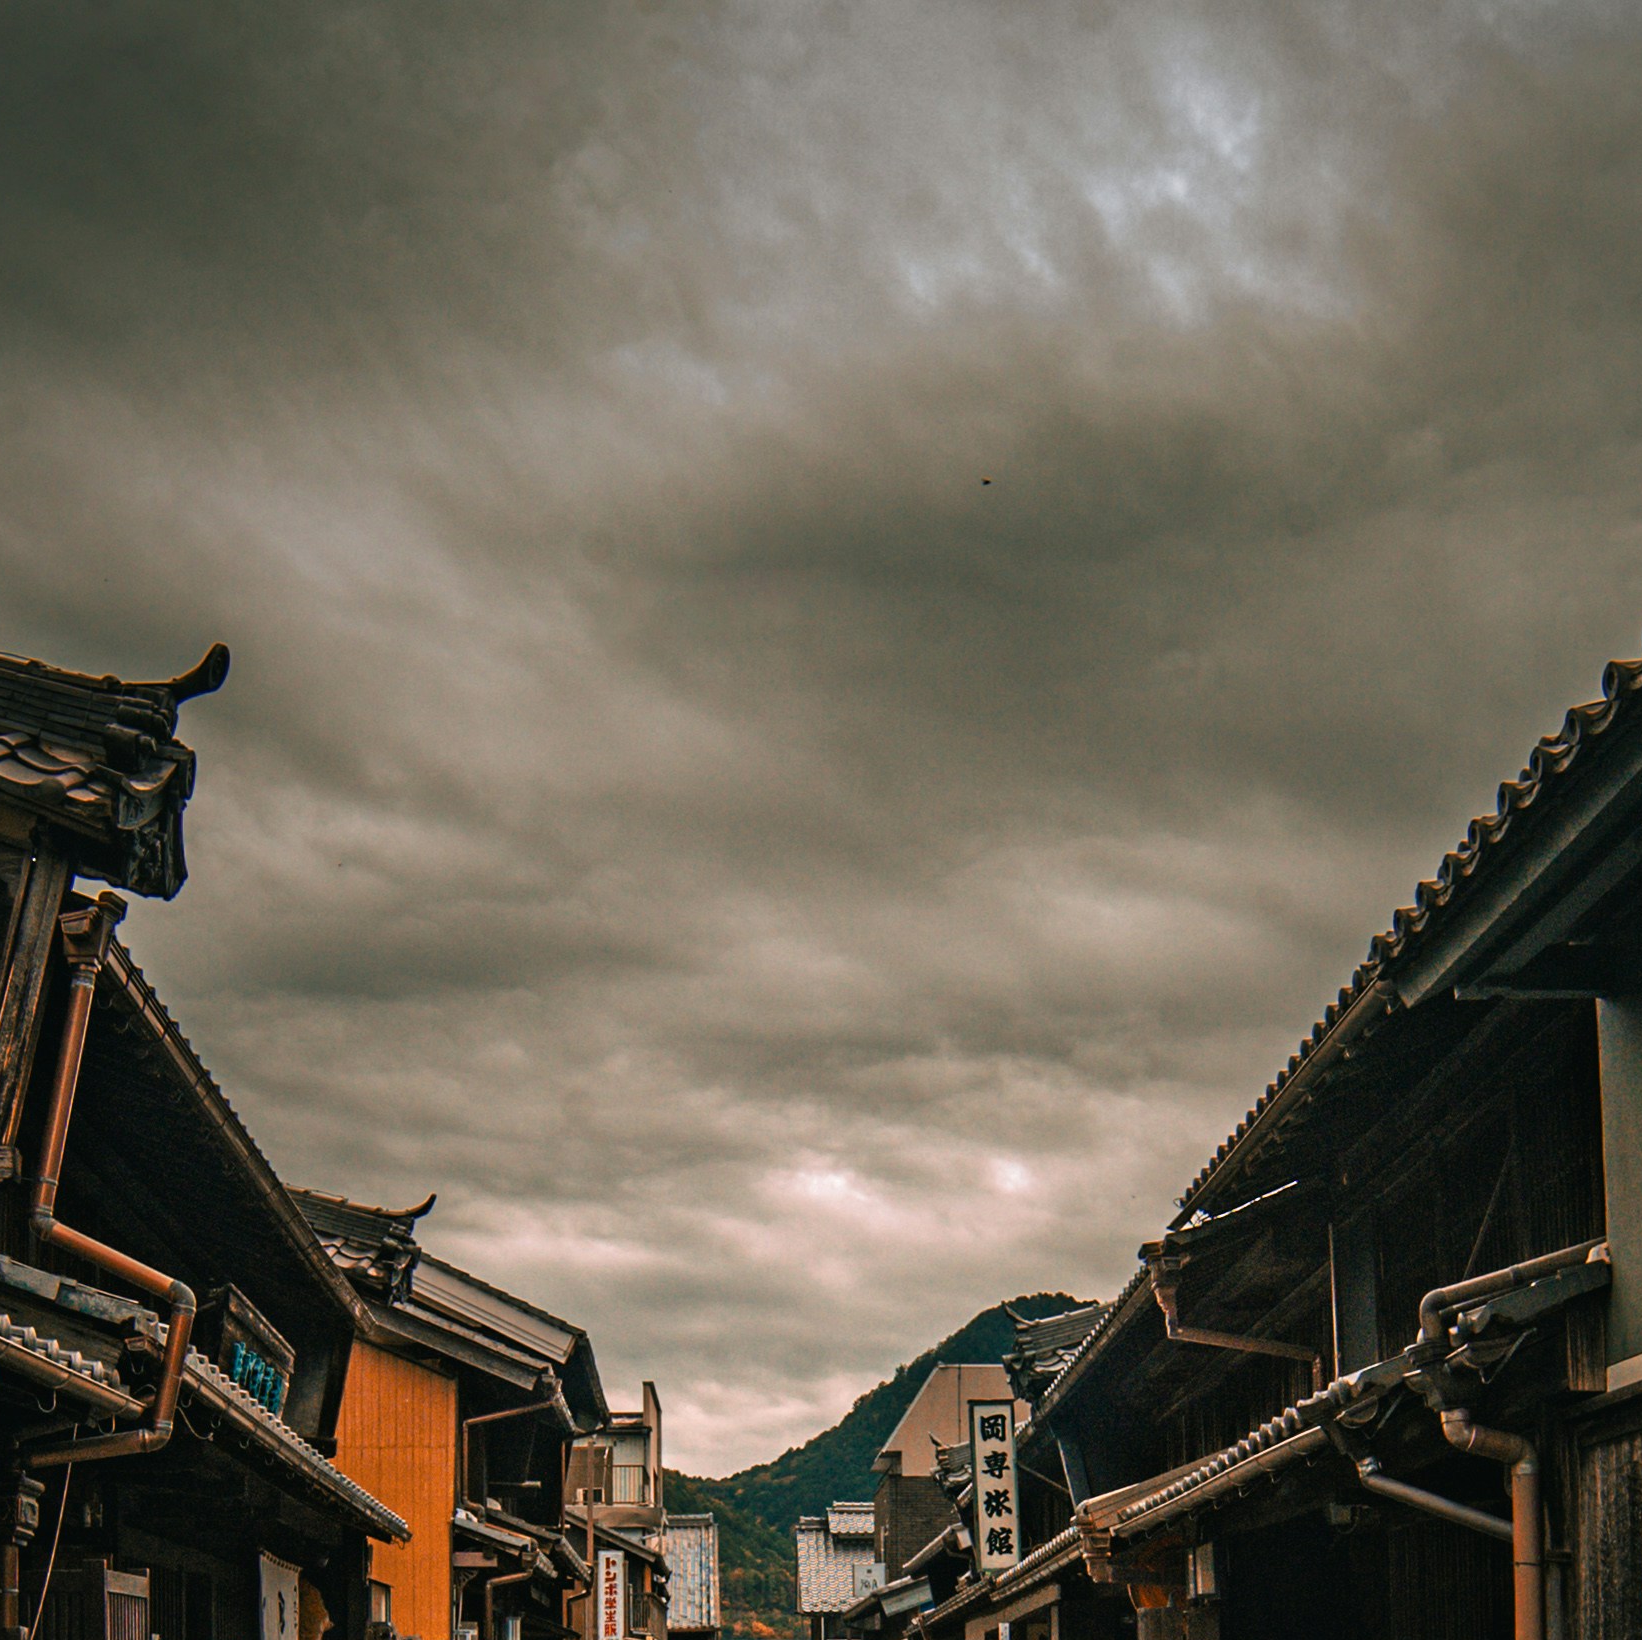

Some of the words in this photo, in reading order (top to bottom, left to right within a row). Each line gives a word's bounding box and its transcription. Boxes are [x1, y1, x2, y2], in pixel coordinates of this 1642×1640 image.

[980, 1414, 1014, 1556] 岡専旅館
[604, 1557, 617, 1637] トンボ学生服
